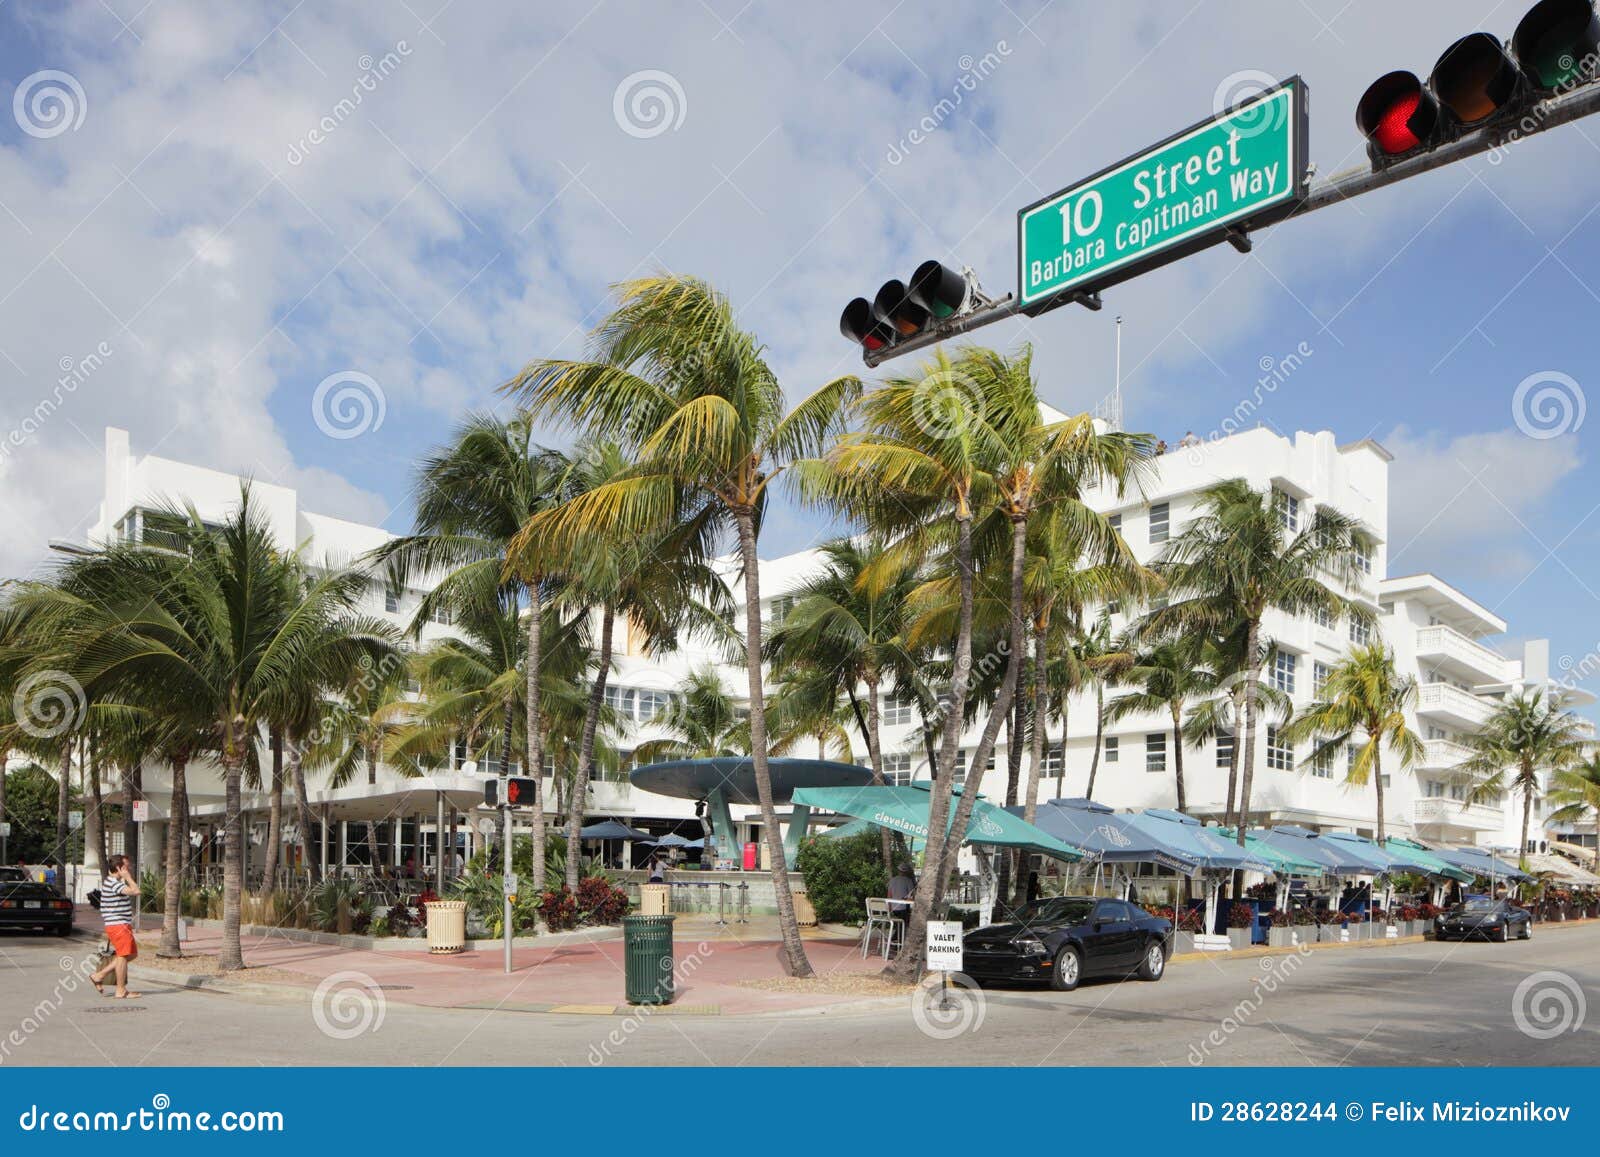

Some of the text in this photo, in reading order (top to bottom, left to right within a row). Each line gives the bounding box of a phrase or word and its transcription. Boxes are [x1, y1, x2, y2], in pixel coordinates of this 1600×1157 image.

[1058, 128, 1241, 245] 10 Street
[1031, 161, 1279, 287] Barbara Capitman Way
[874, 811, 929, 836] clevelande
[928, 945, 961, 954] PARKING
[933, 934, 956, 942] VALET
